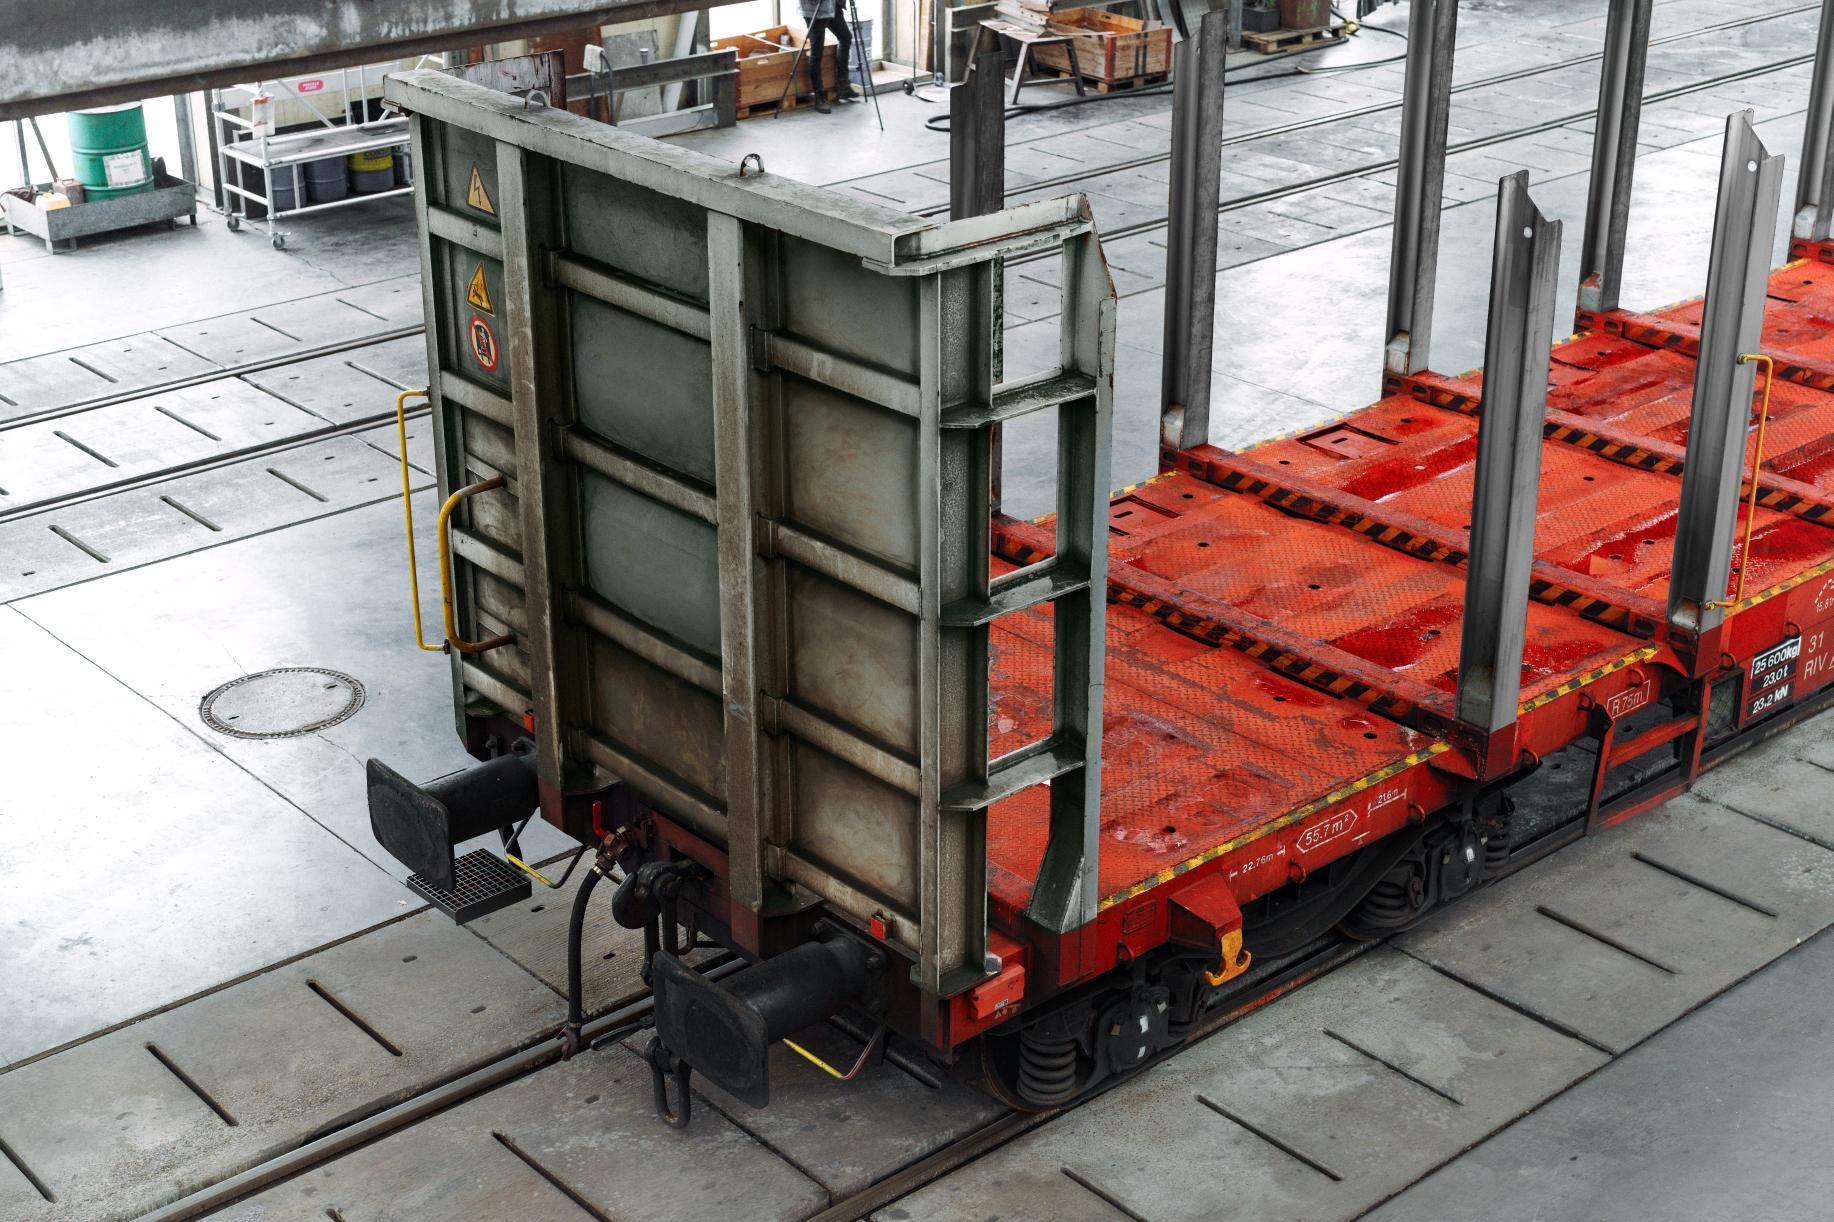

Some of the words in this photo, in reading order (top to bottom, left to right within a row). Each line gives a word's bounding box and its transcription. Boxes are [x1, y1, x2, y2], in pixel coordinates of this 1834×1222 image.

[1808, 630, 1825, 653] 31
[1803, 652, 1829, 681] RIV
[1305, 822, 1330, 846] 55.7
